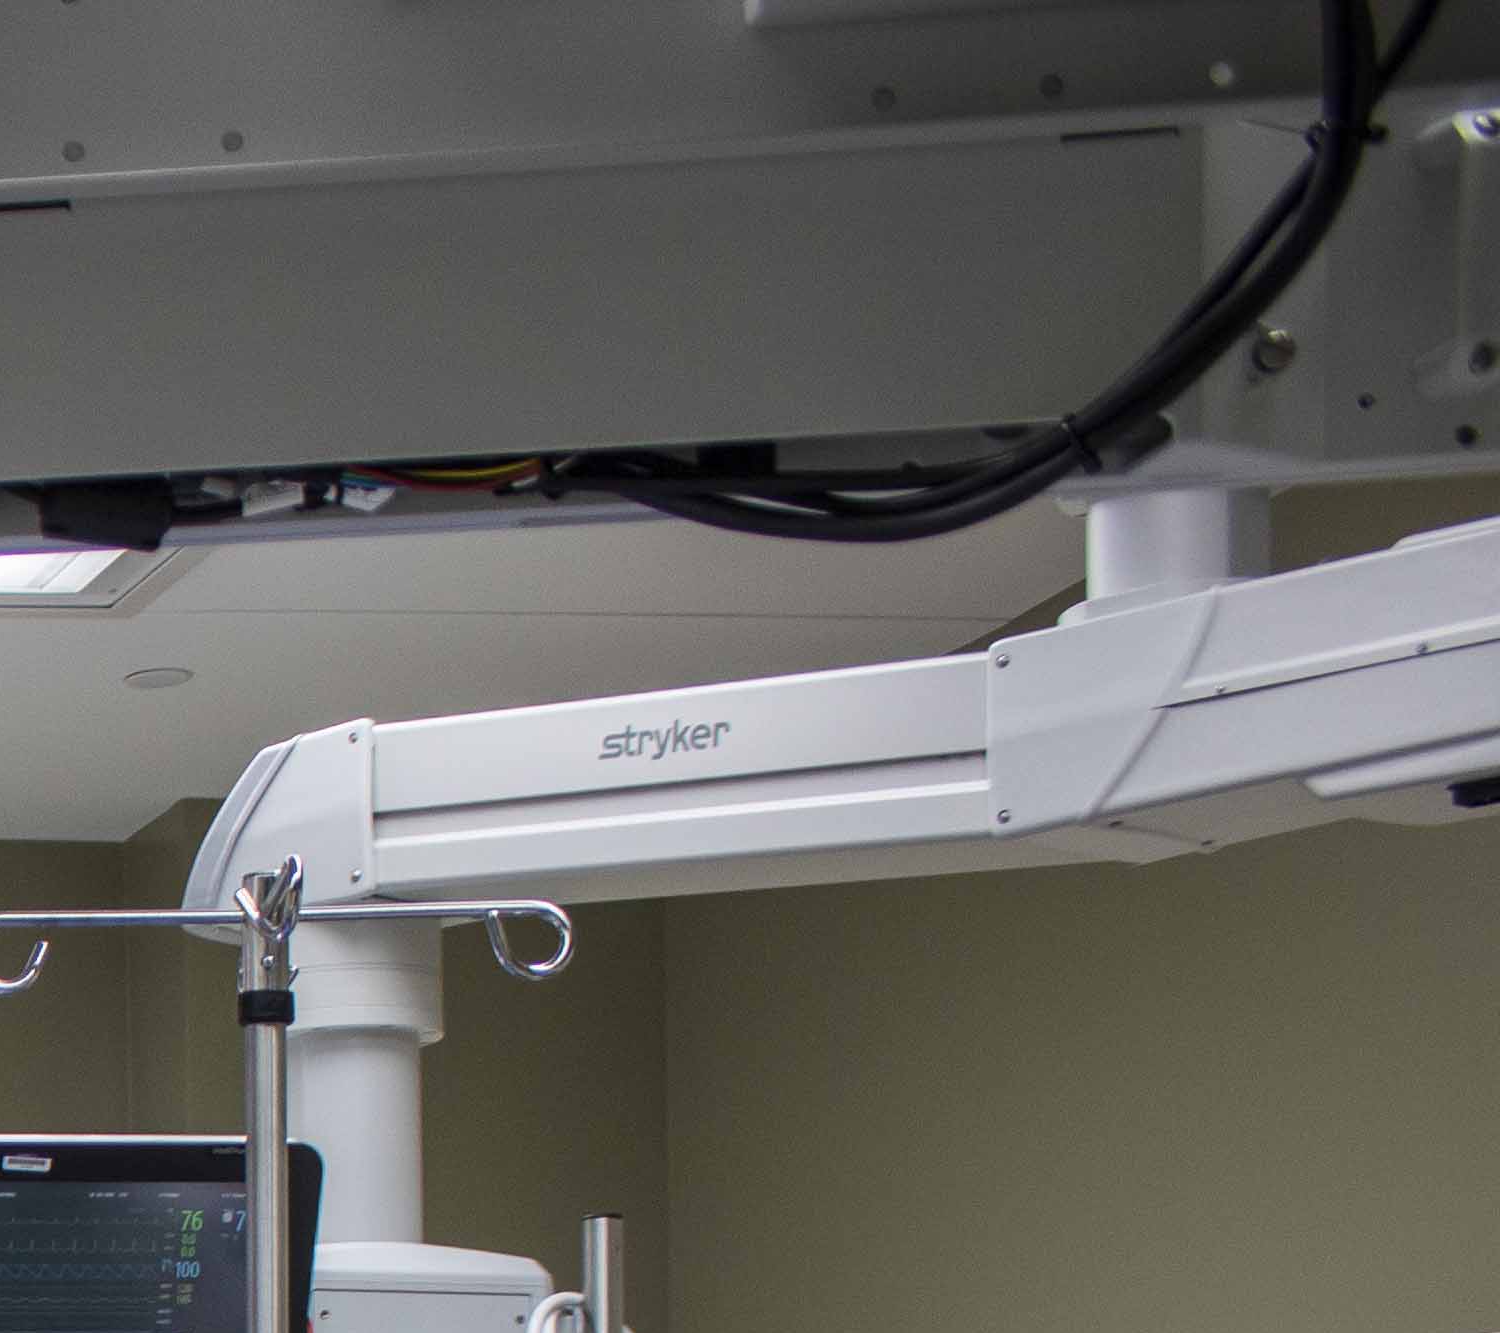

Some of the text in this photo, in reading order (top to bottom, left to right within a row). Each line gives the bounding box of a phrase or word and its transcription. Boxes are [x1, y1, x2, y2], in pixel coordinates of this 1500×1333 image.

[597, 717, 731, 761] stryker
[181, 1209, 204, 1232] 76
[175, 1260, 201, 1279] 100
